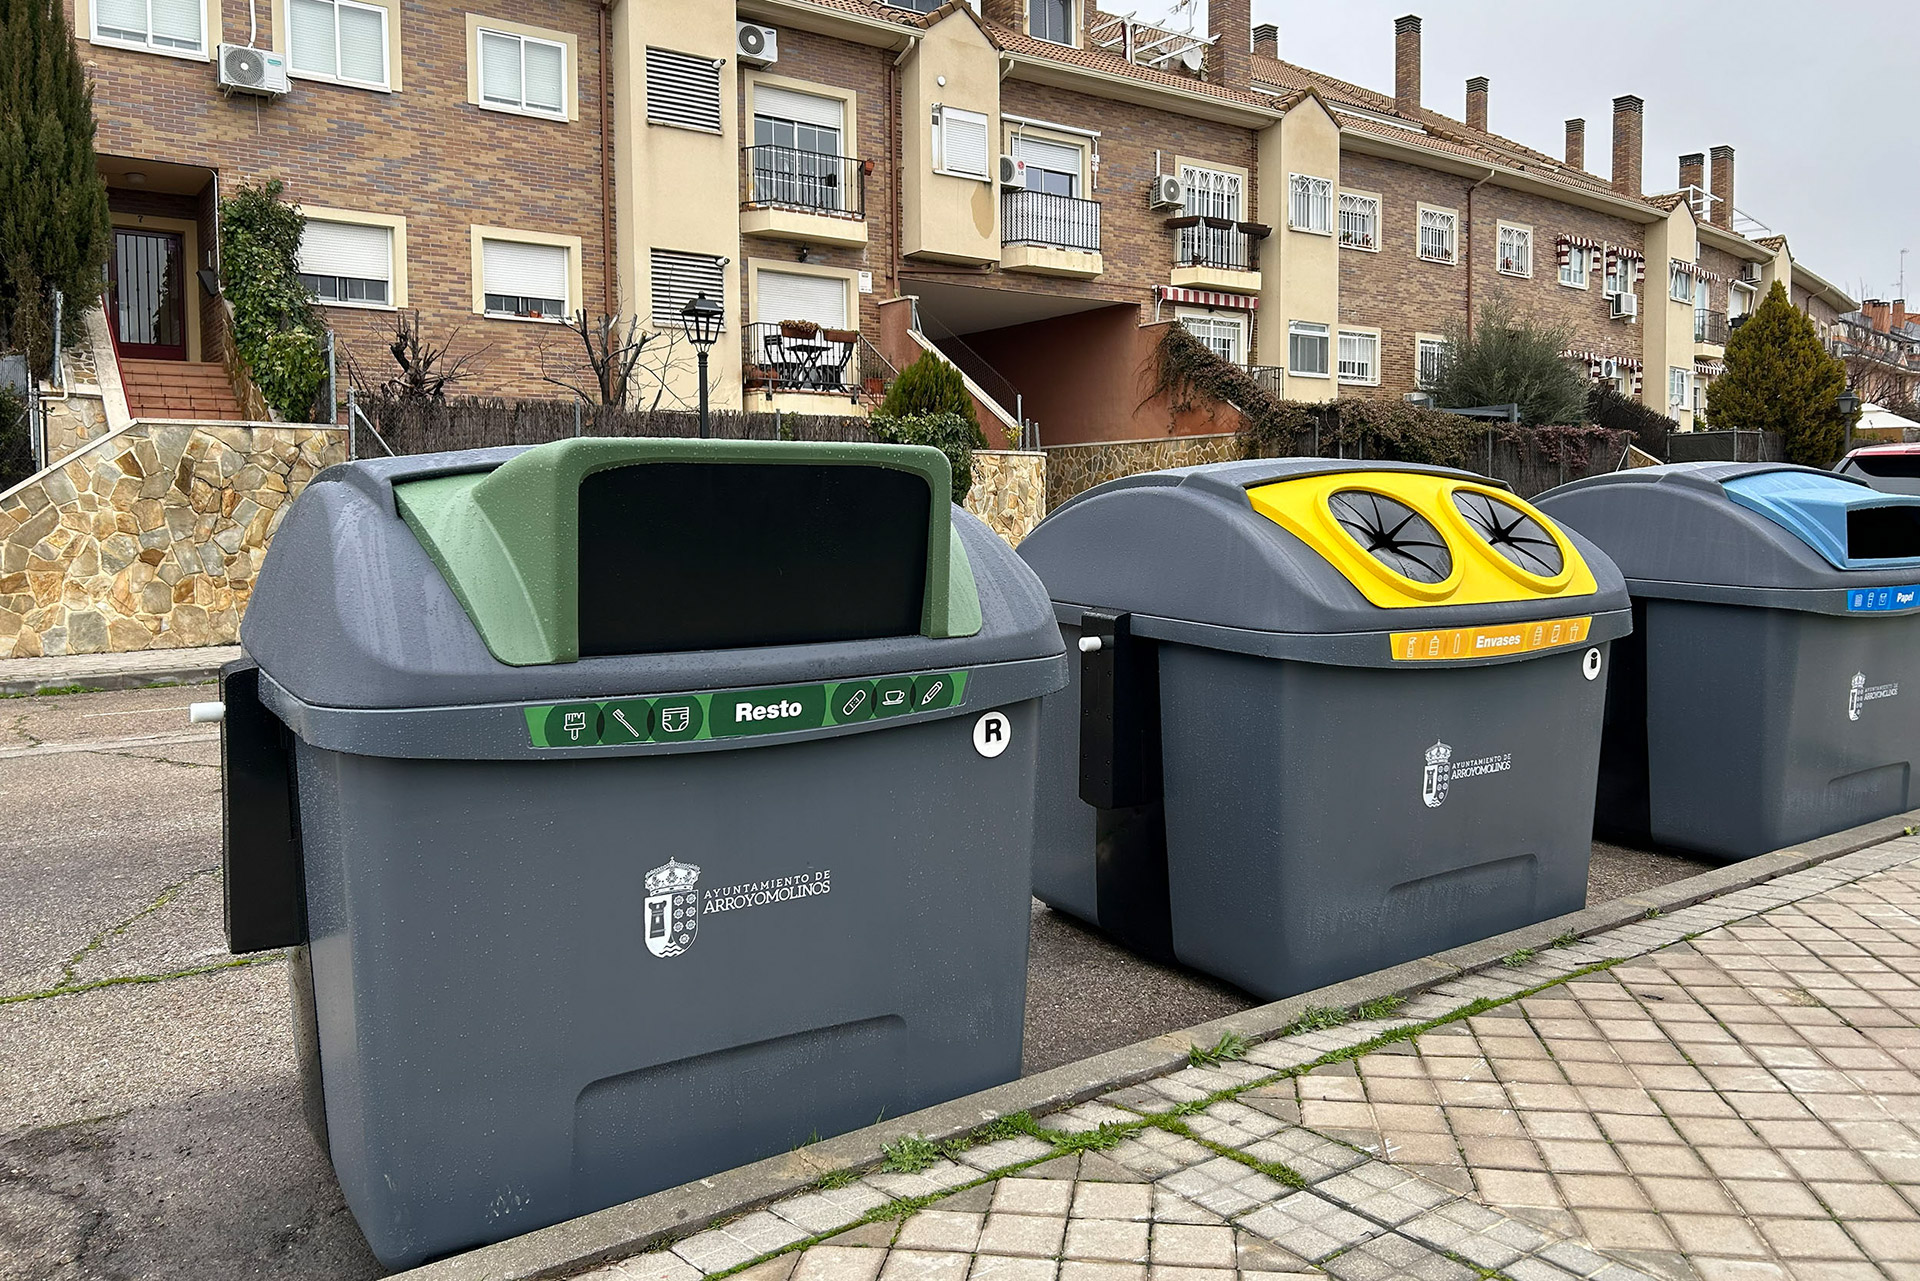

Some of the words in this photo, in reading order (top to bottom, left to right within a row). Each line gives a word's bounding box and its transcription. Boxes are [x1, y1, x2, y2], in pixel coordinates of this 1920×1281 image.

[1896, 592, 1914, 604] Papel
[1476, 634, 1521, 648] Envases
[735, 701, 803, 722] Resto
[985, 718, 1002, 743] R
[1451, 761, 1511, 780] ARROYOMOLINOS
[1452, 755, 1502, 769] AYUNTAMIENTO
[704, 874, 810, 899] AYUNTAMIENTO
[814, 870, 831, 880] DE
[703, 881, 831, 915] ARROYOMOLINOS
